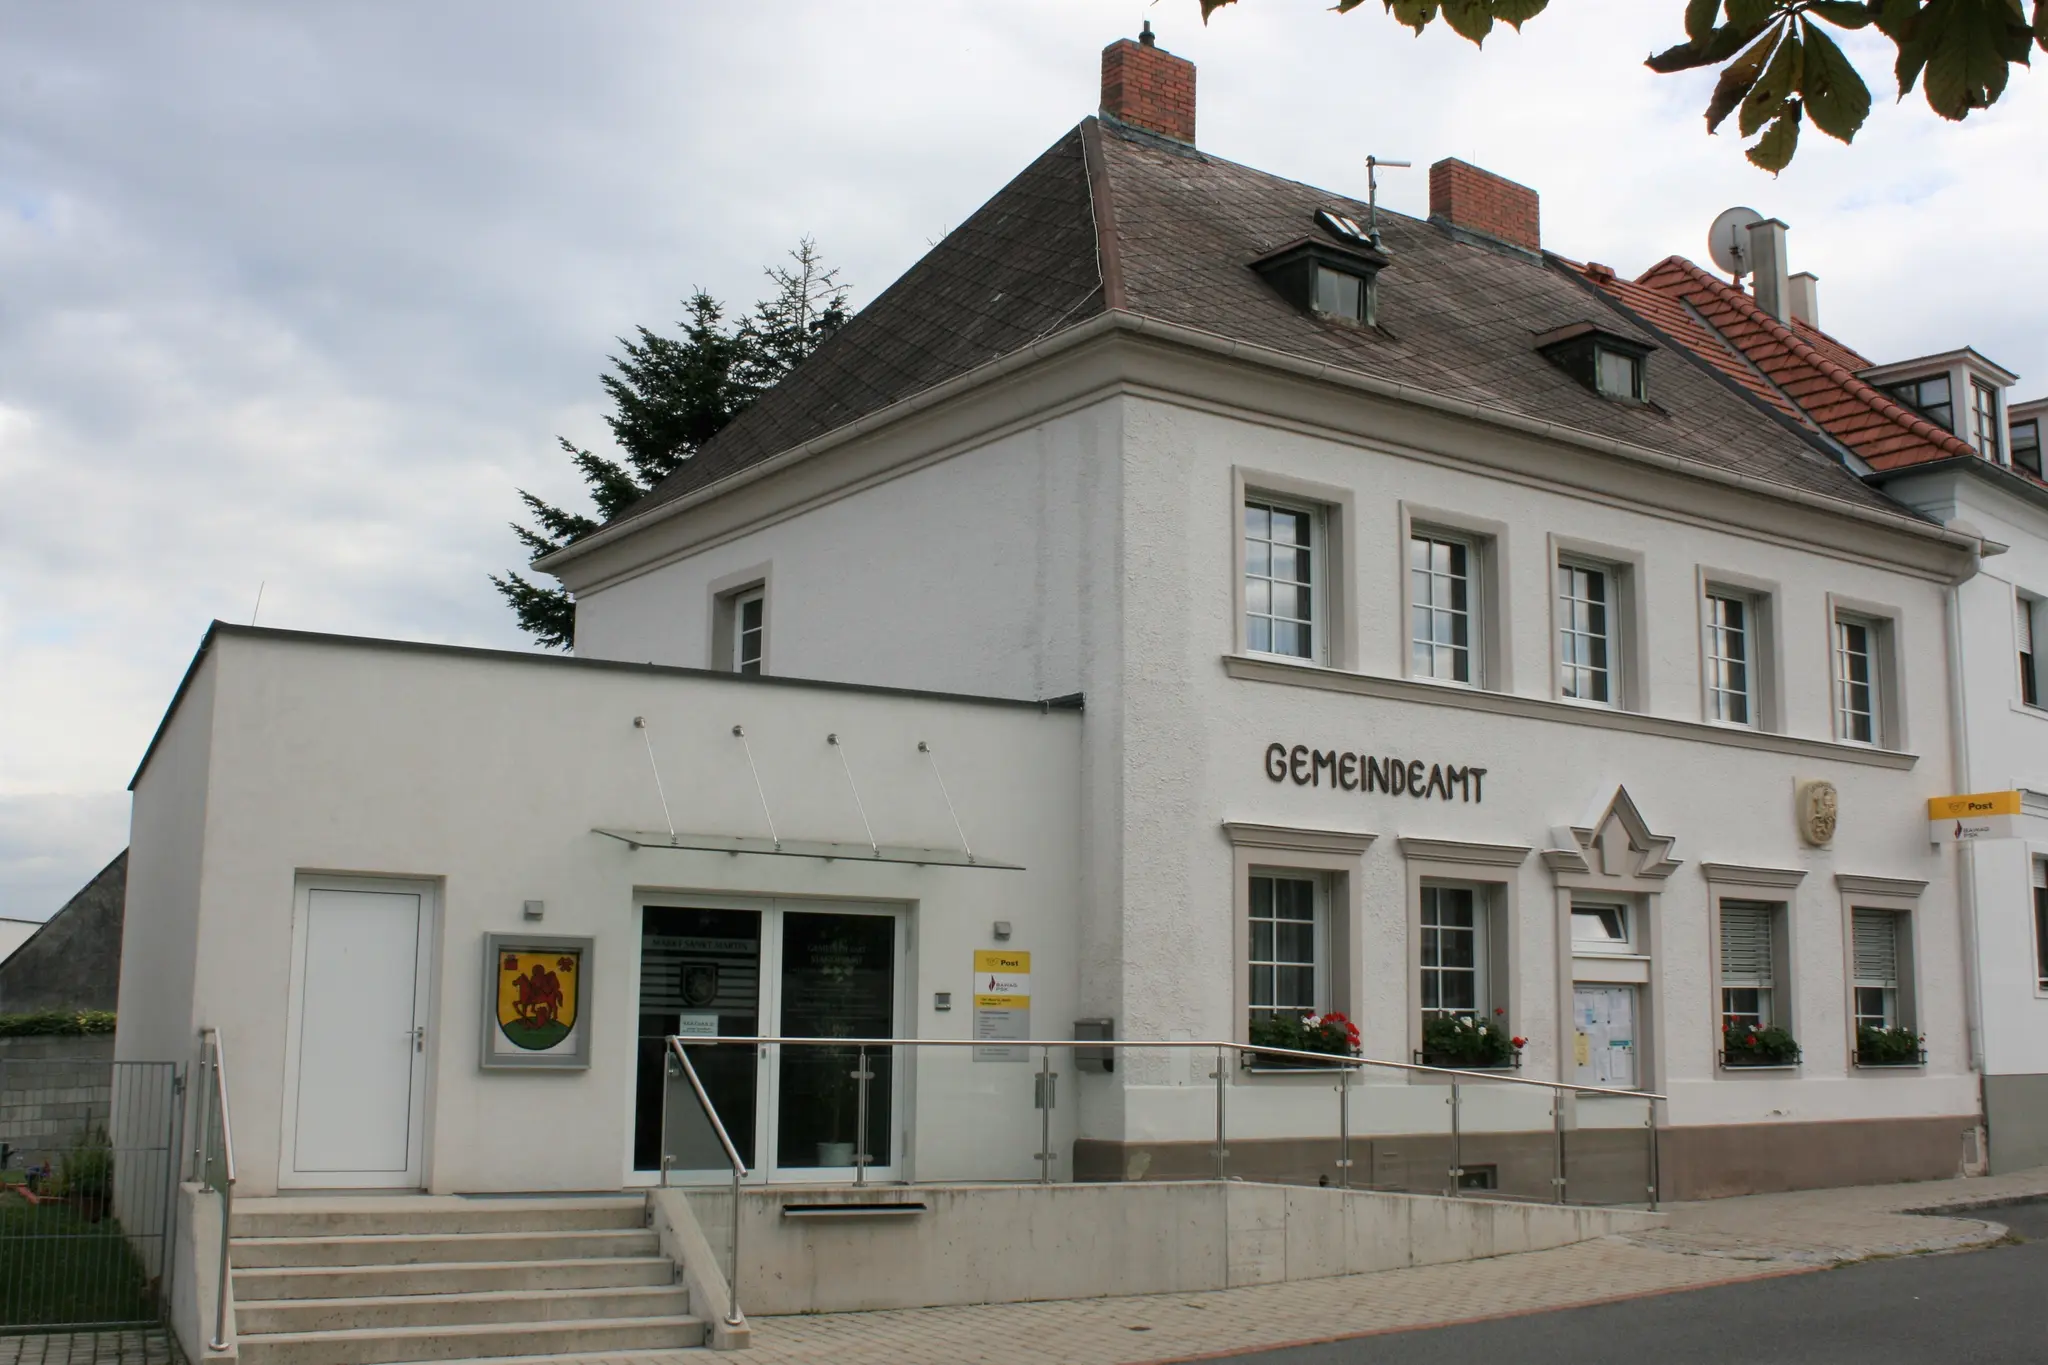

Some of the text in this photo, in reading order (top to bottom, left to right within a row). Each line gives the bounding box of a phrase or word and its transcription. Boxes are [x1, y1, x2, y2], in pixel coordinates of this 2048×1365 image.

[1265, 742, 1488, 803] GEMEINDEAMT
[1968, 801, 1993, 811] Post
[684, 939, 713, 949] SANKT
[714, 941, 749, 951] MARTIN
[1000, 959, 1019, 967] Post
